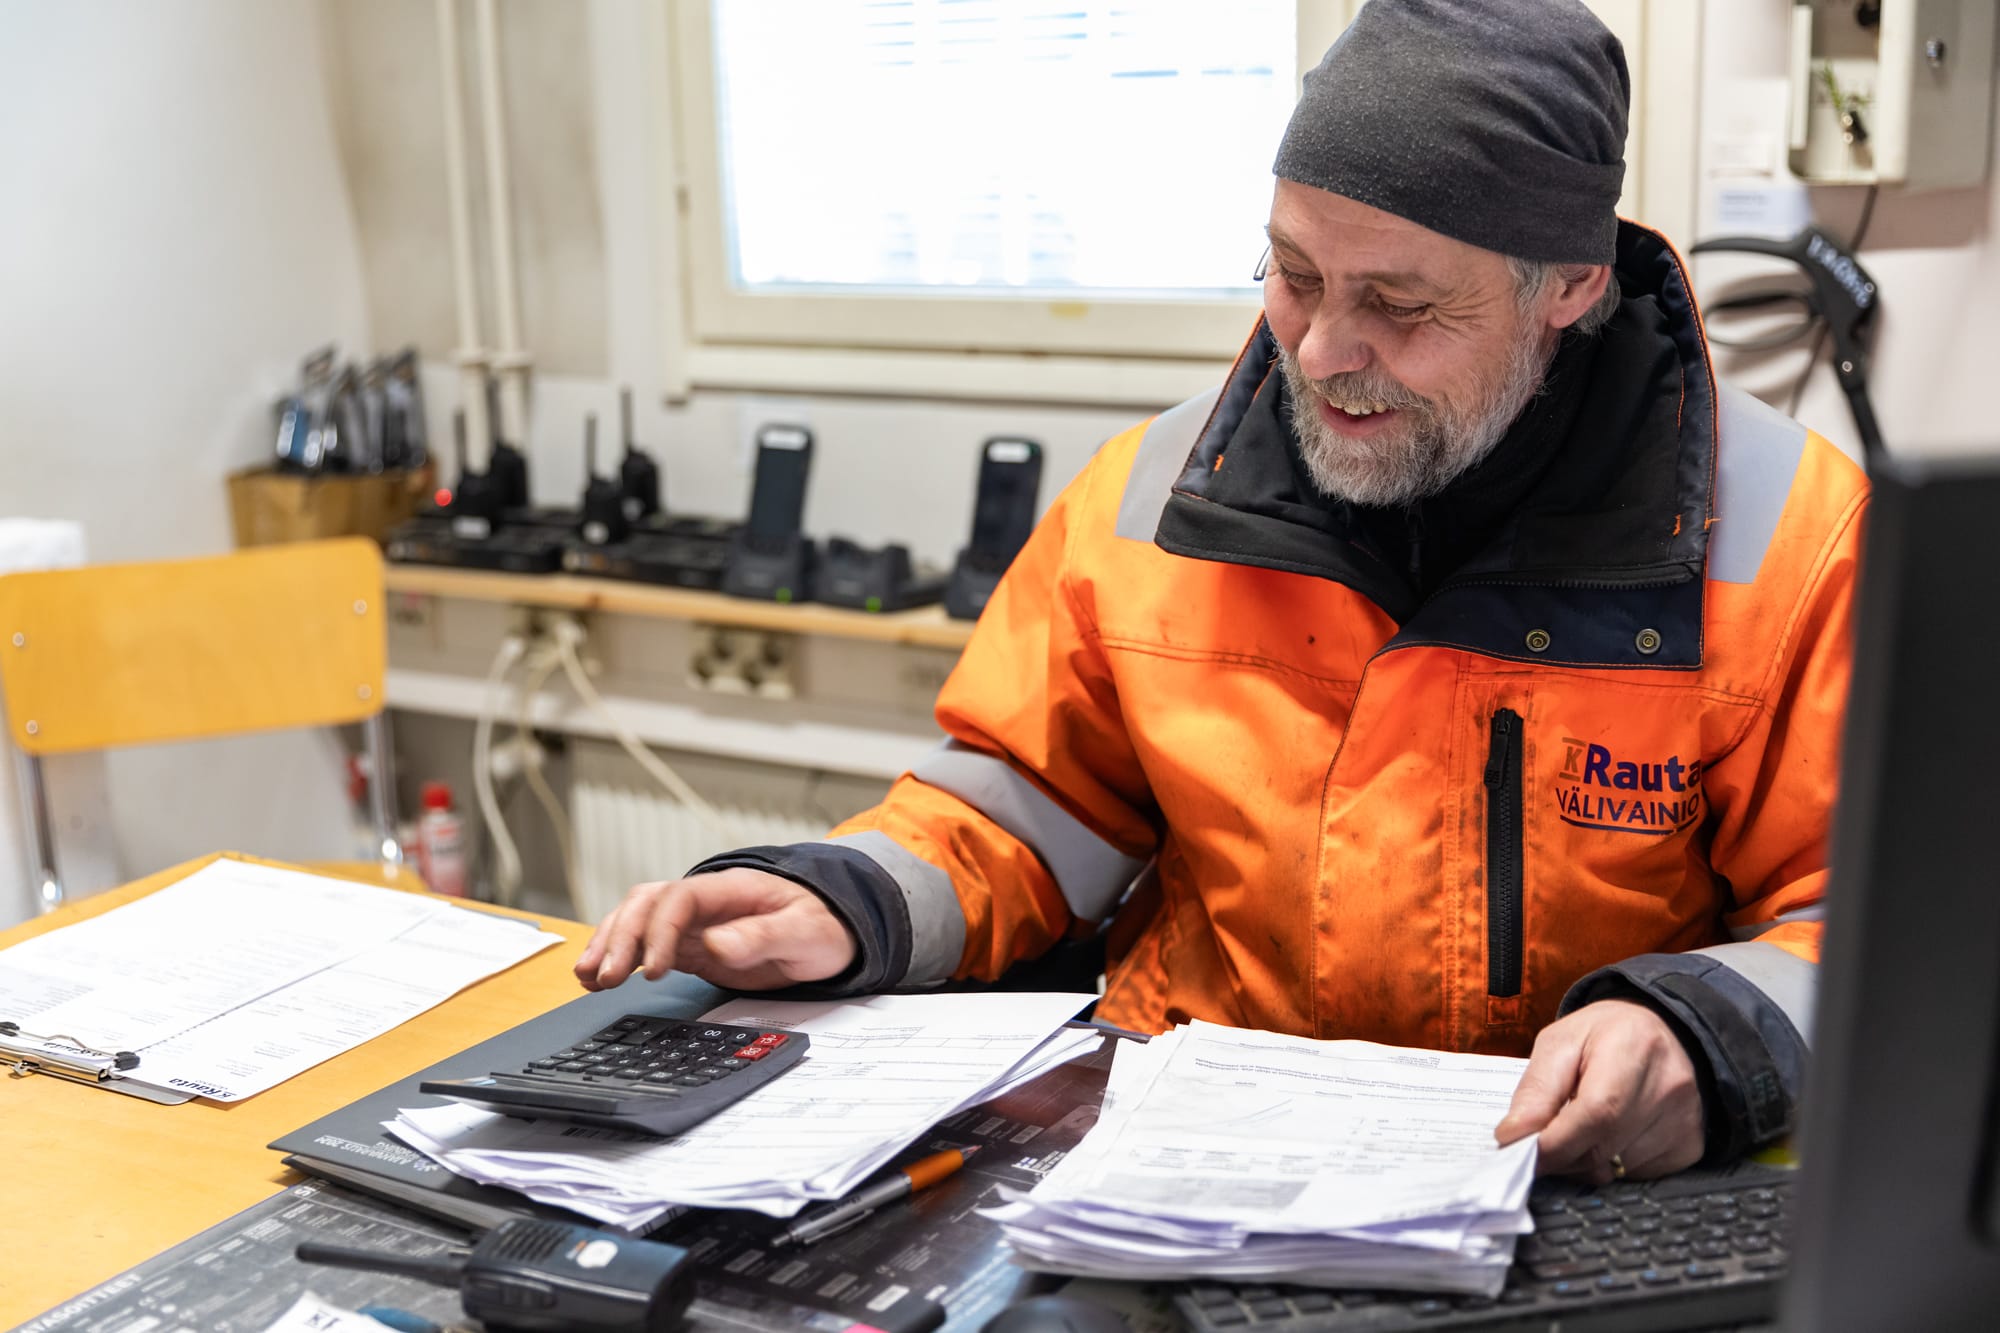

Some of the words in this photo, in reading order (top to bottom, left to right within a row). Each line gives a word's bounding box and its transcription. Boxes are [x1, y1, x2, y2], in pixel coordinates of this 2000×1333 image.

[1555, 786, 1700, 826] VÄLIVAINIO
[704, 1029, 722, 1037] 00
[168, 1078, 222, 1096] Rauta
